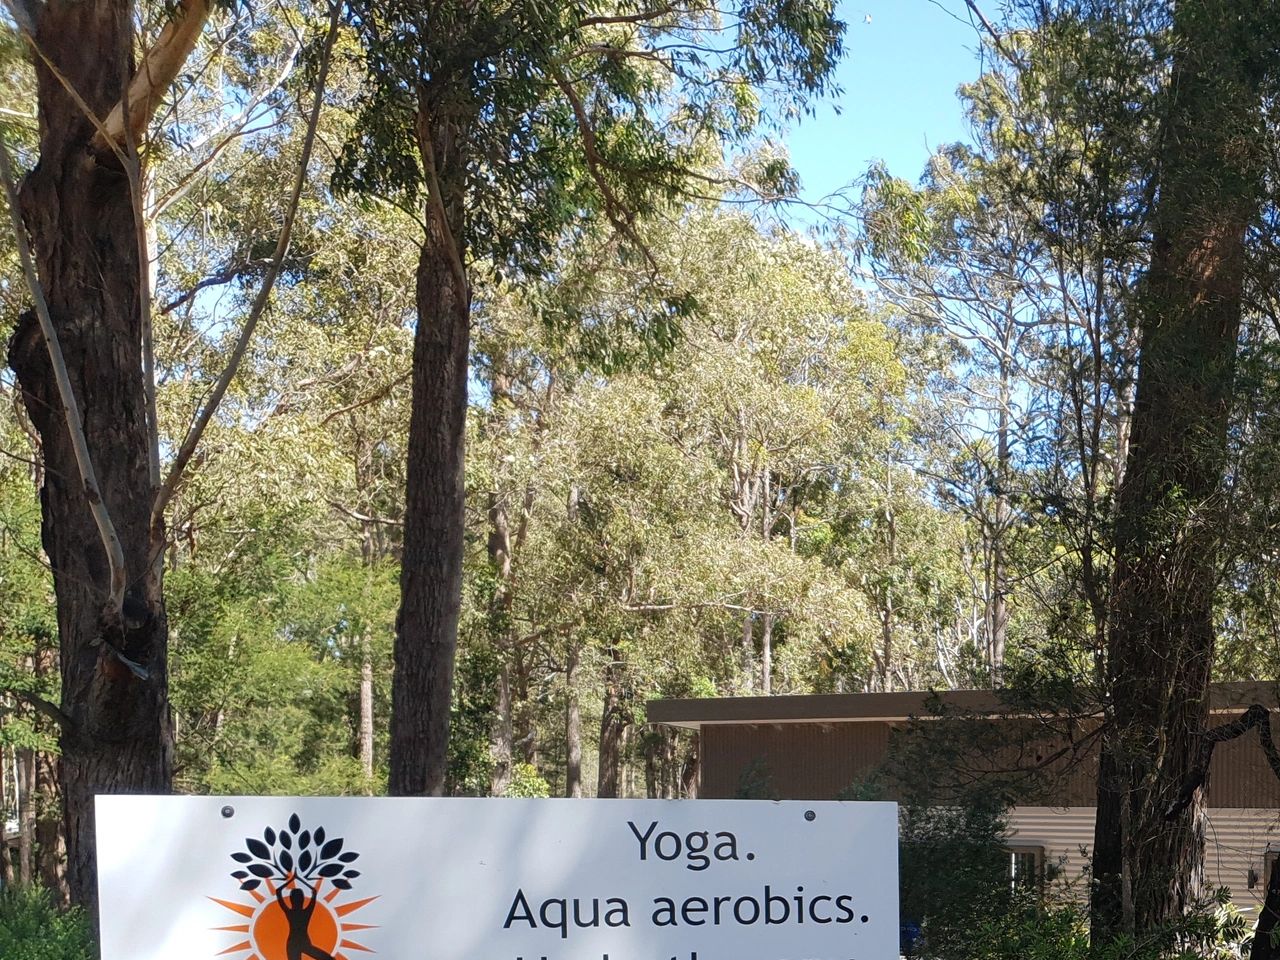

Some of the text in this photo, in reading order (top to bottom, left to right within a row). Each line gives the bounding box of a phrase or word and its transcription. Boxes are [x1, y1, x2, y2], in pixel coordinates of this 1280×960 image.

[626, 820, 756, 872] Yoga.
[502, 884, 869, 939] Aqua aerobics.
